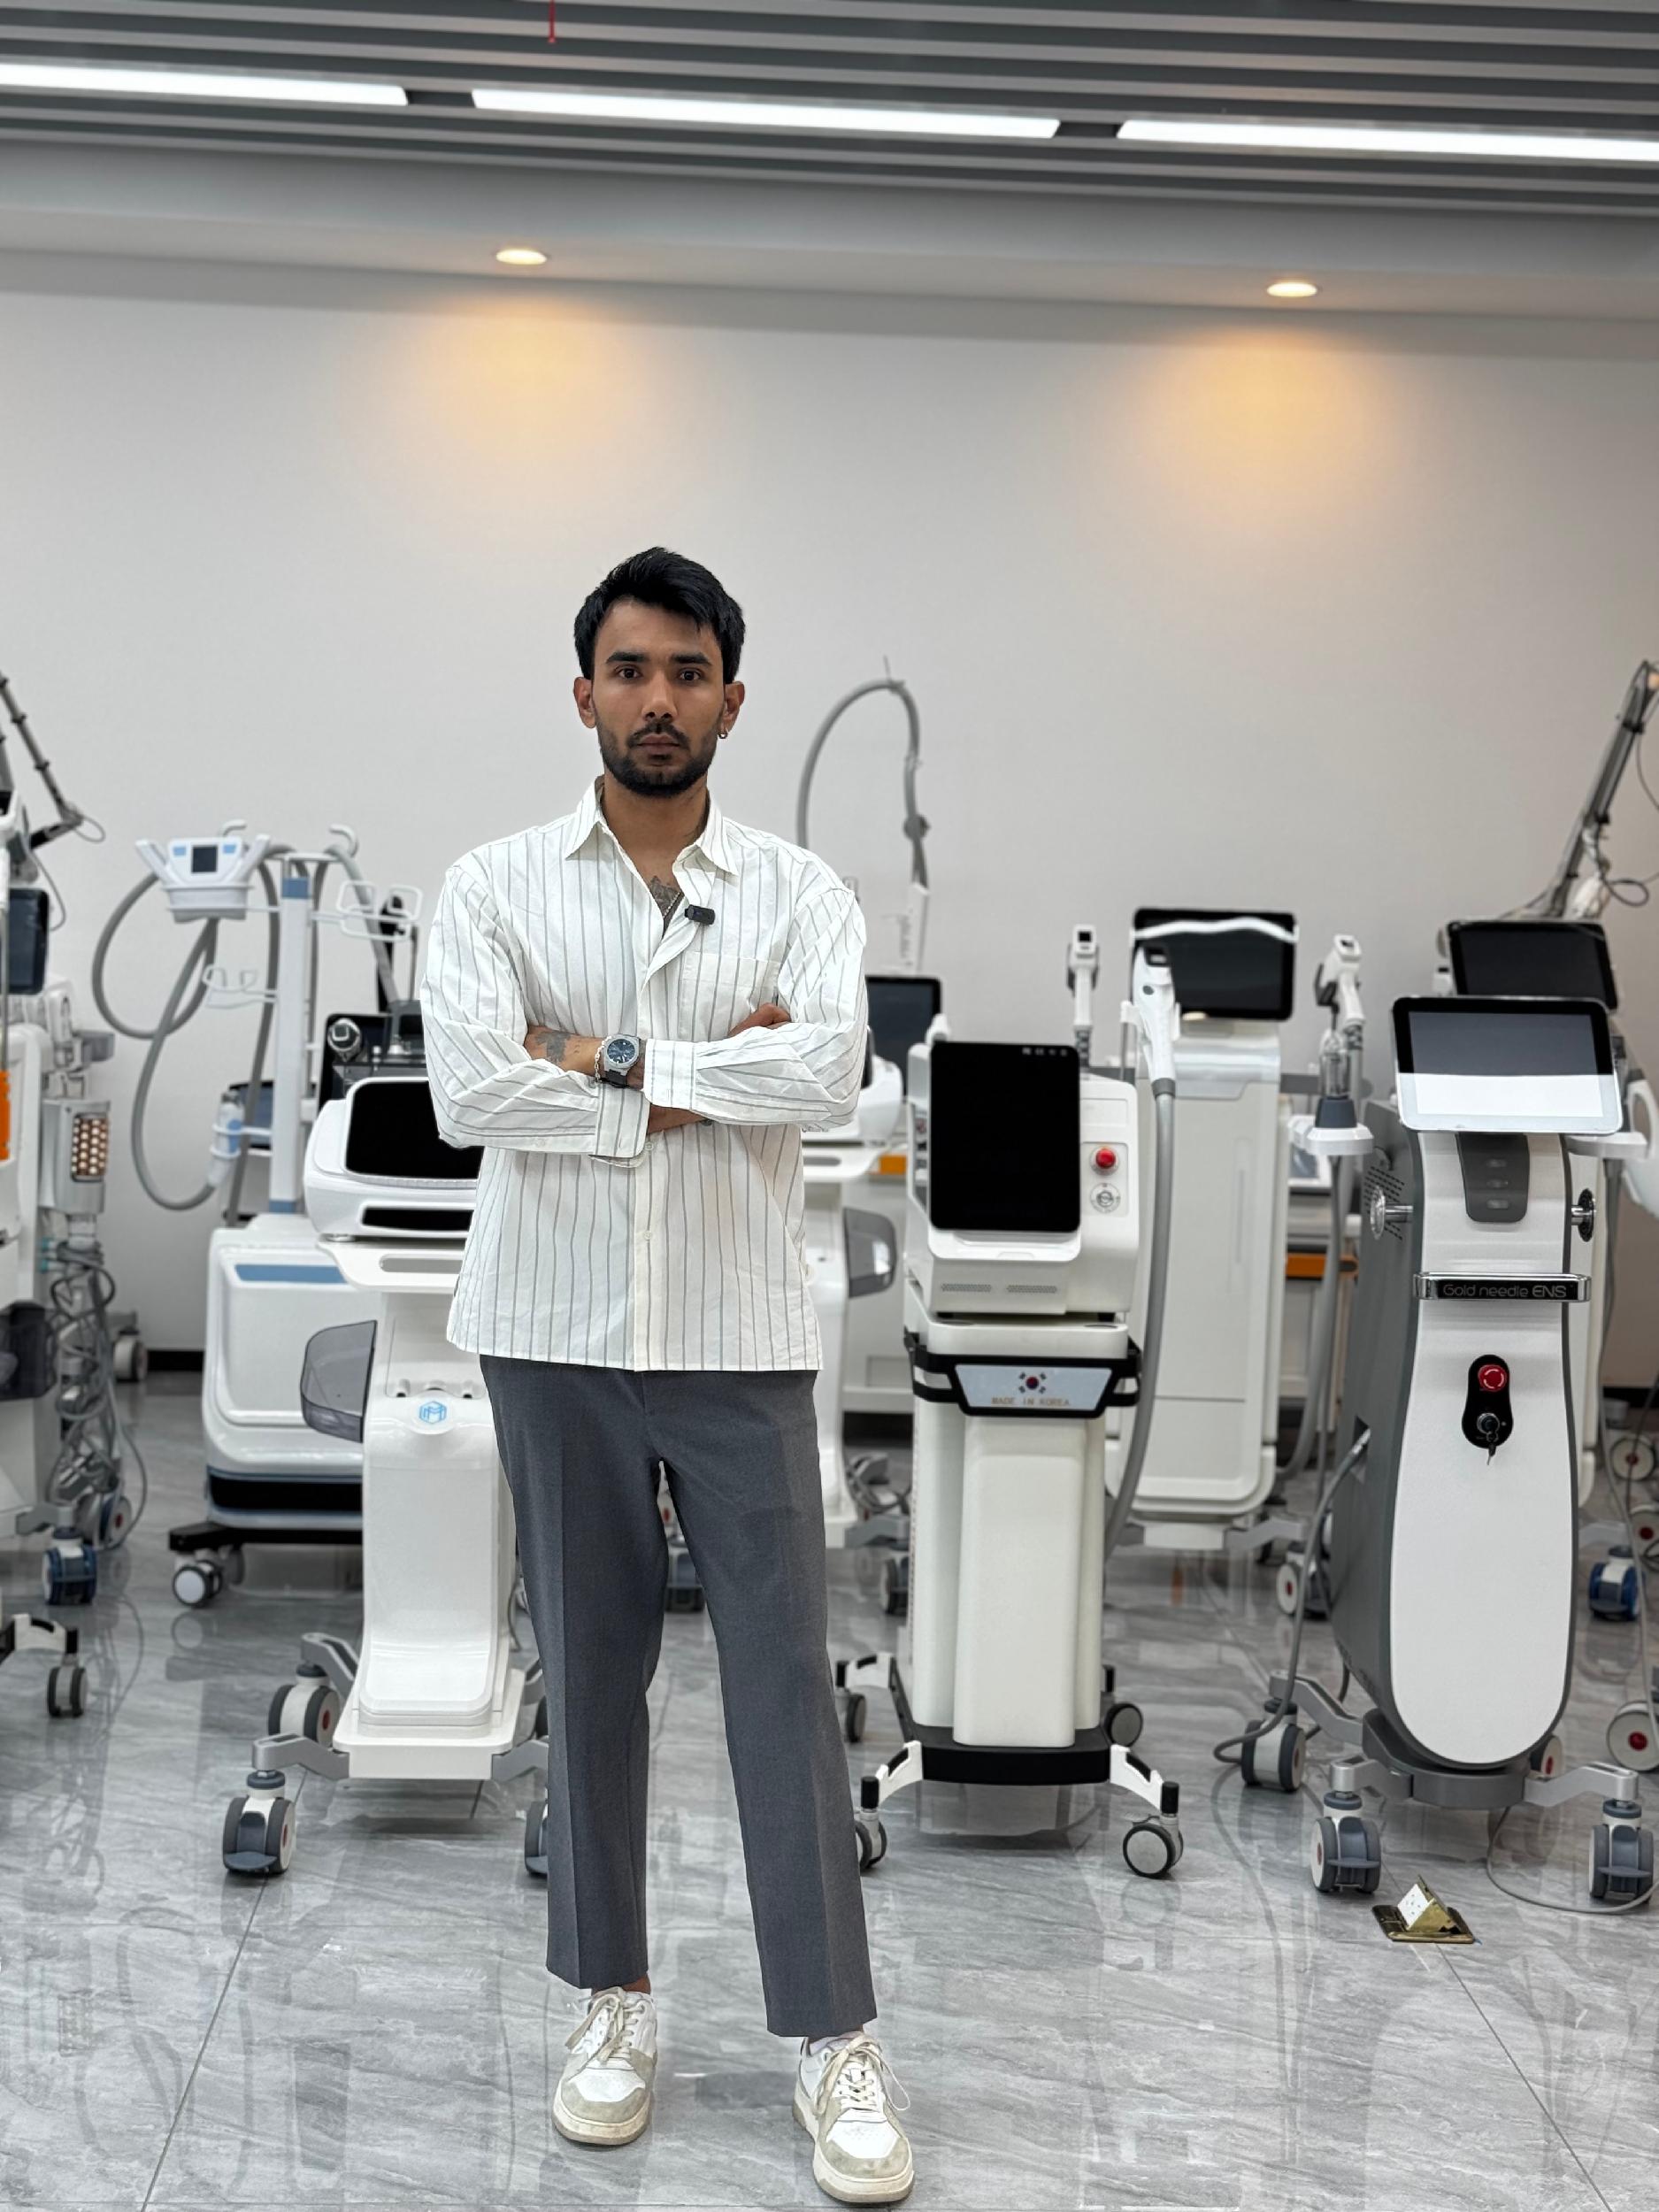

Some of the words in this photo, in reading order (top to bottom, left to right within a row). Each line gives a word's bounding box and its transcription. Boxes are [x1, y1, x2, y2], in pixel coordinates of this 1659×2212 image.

[1443, 1284, 1476, 1296] Gold
[1479, 1285, 1528, 1297] needle
[1532, 1285, 1567, 1298] ENS
